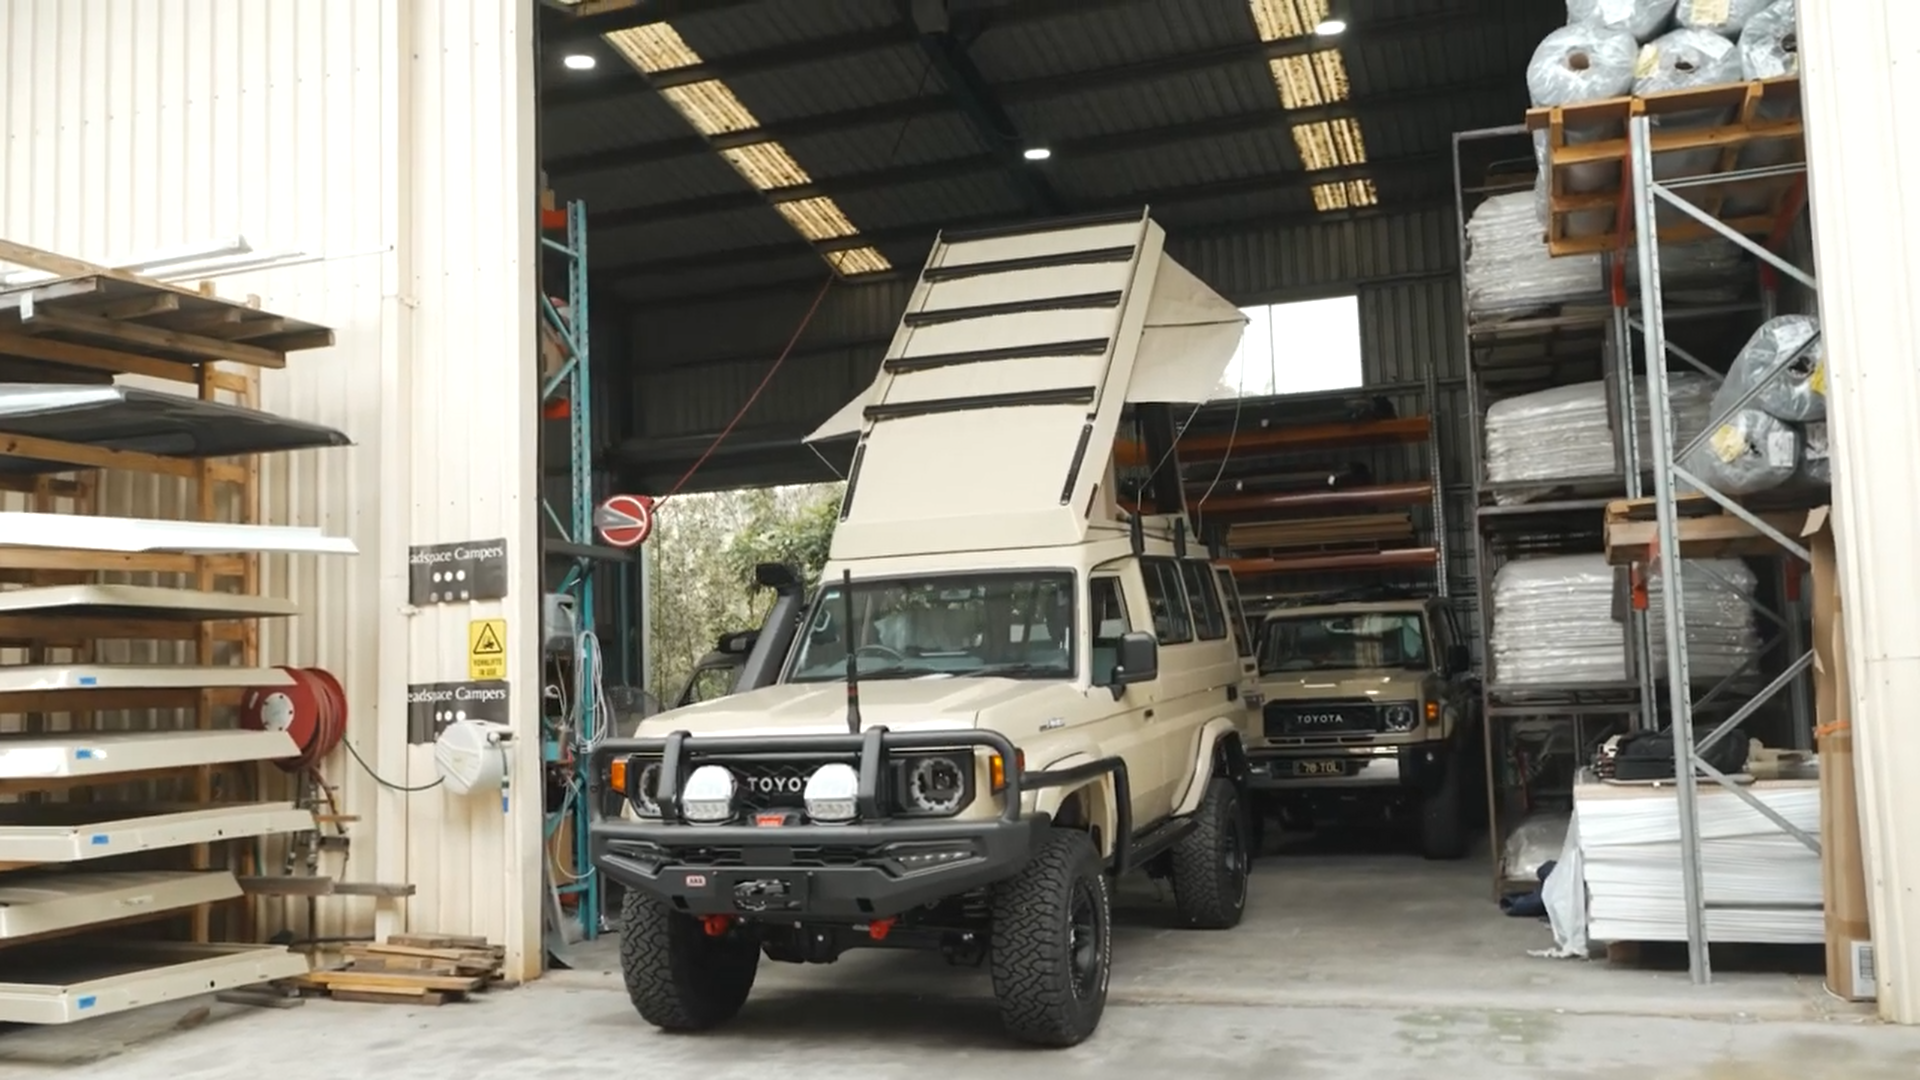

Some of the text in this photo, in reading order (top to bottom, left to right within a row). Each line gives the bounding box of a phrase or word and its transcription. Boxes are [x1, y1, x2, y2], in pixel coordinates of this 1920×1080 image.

[454, 546, 504, 562] Campers
[455, 686, 506, 703] Campers
[1297, 714, 1343, 723] TOYOTA
